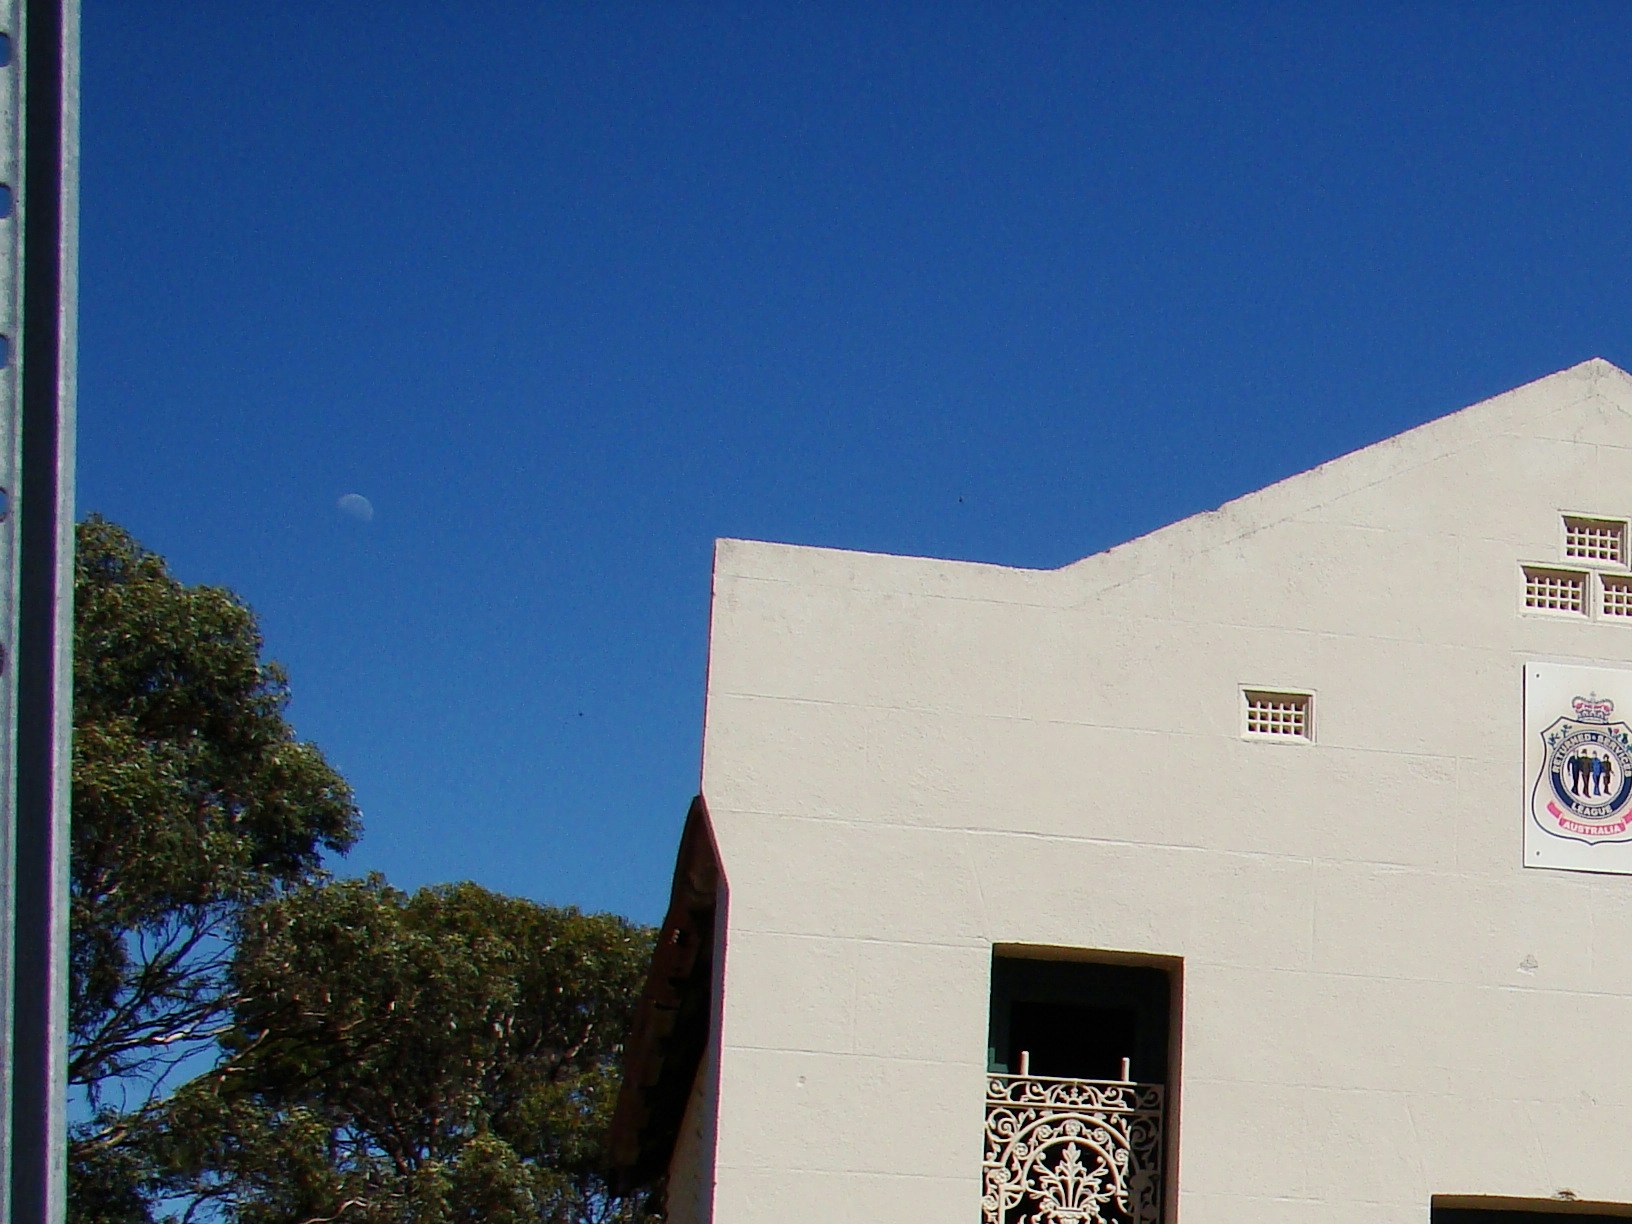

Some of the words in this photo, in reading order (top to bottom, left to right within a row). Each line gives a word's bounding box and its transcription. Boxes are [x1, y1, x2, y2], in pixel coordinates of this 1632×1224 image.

[1552, 733, 1591, 773] RETURNED
[1598, 735, 1632, 777] SERVICES
[1571, 803, 1613, 816] LEAGUE
[1564, 821, 1621, 835] AUSTRALIA
